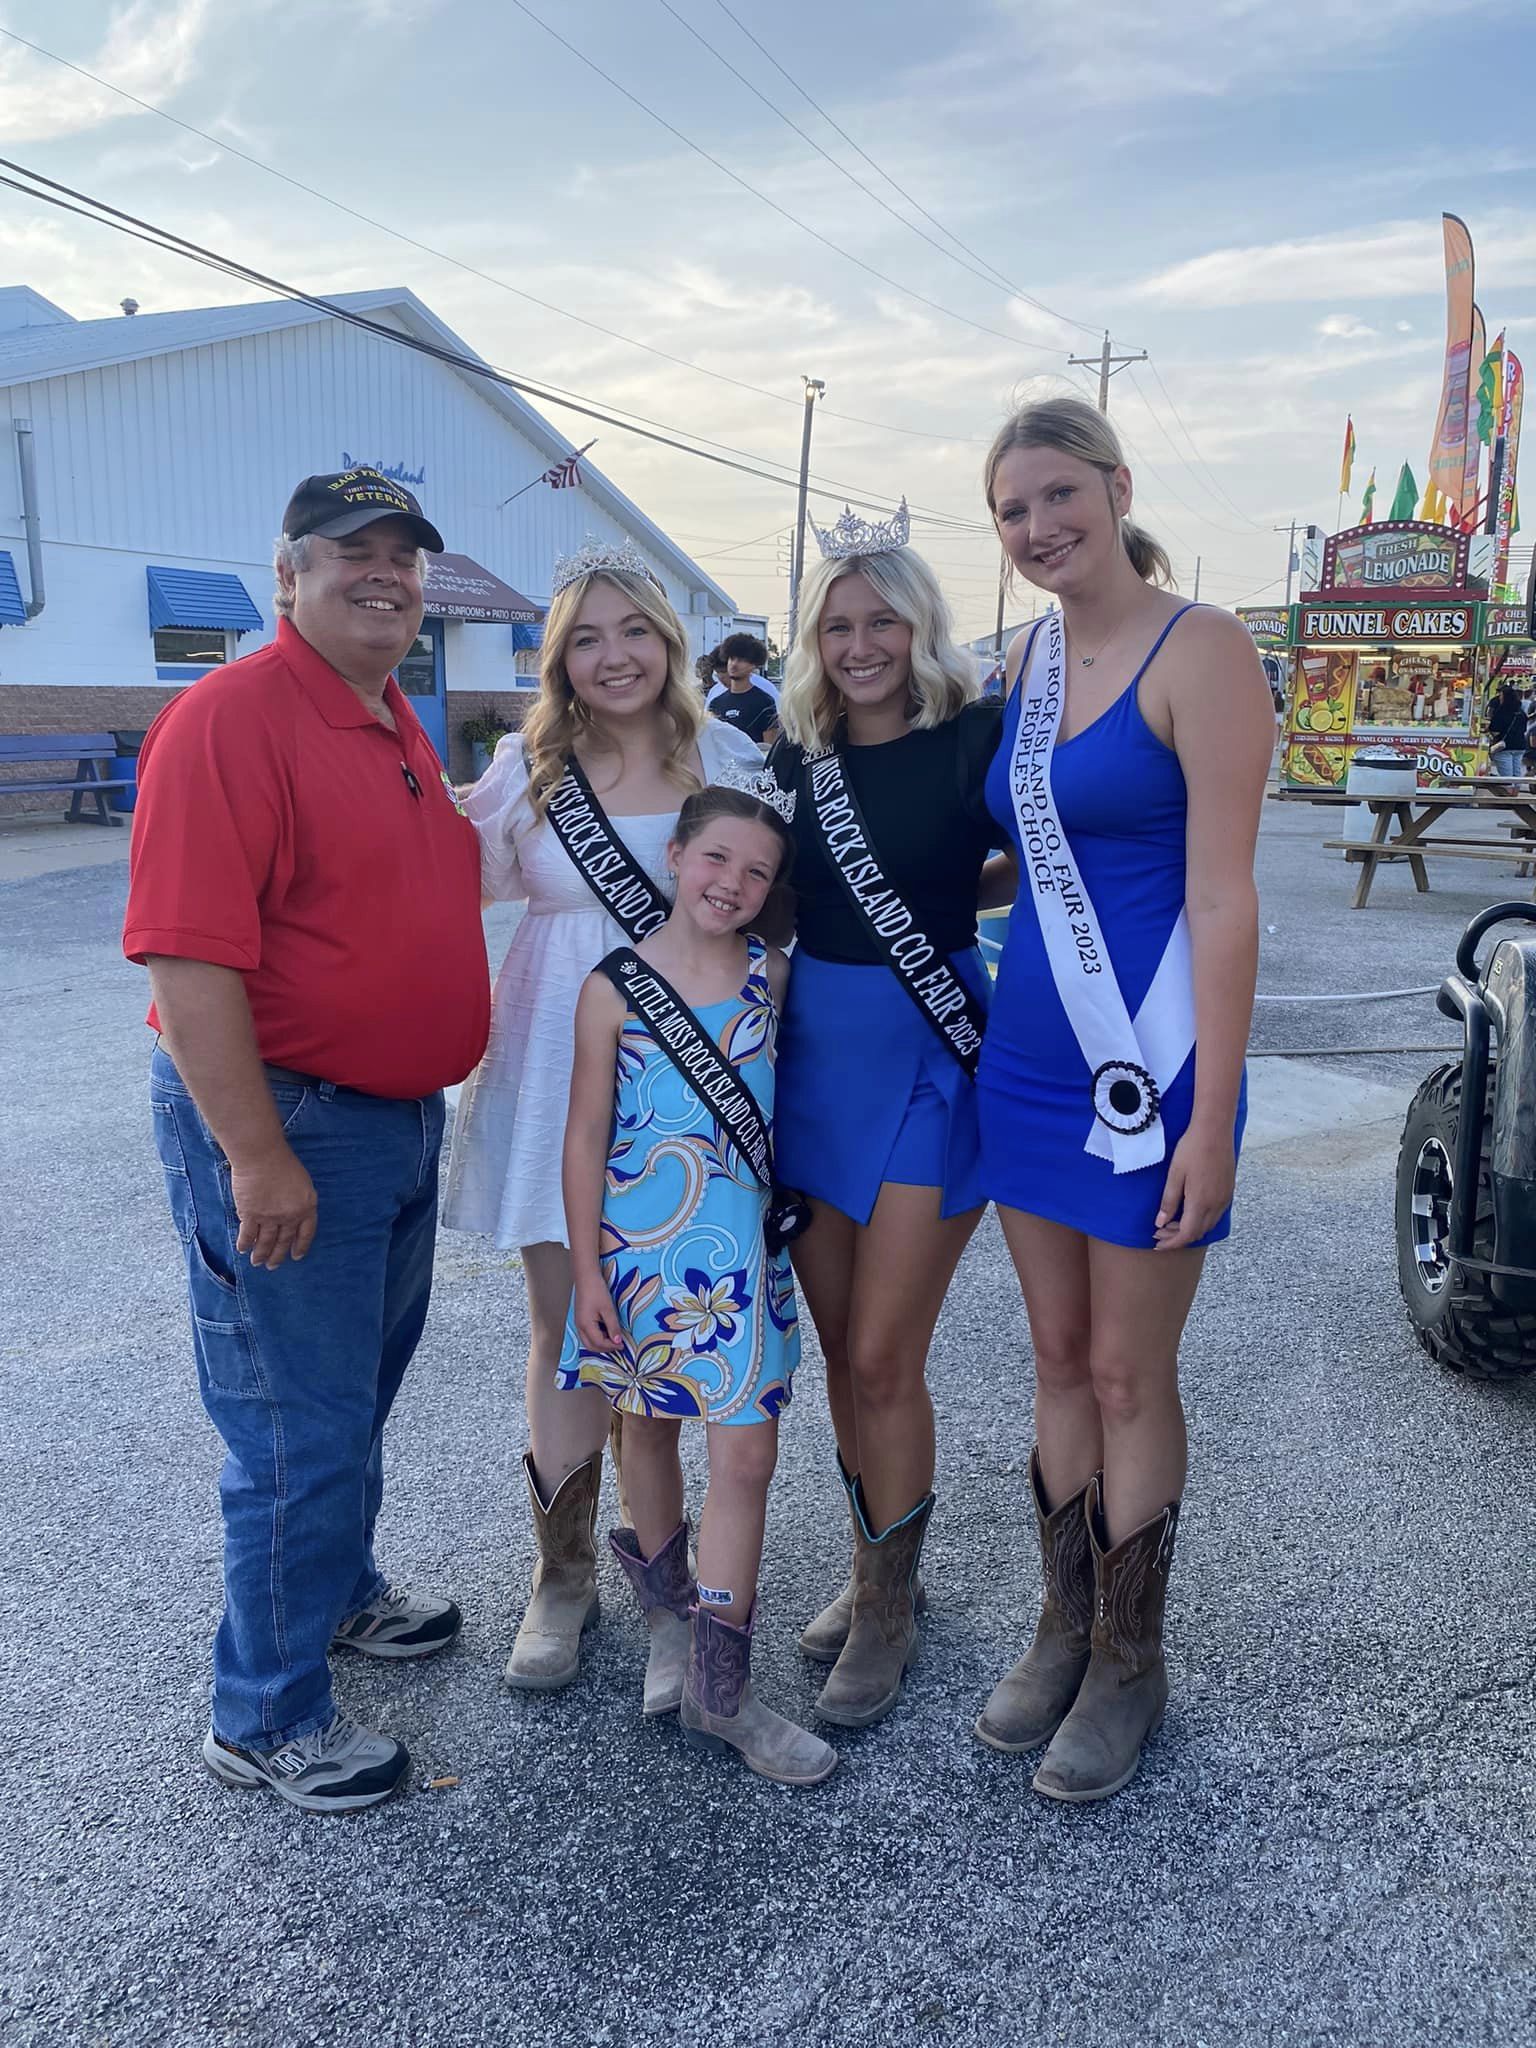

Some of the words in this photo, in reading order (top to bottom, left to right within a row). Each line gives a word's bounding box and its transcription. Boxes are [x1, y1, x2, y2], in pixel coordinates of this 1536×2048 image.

[327, 472, 359, 492] IRAQI
[343, 491, 410, 511] VETERAN
[1364, 551, 1450, 581] LEMONADE
[1379, 538, 1418, 556] FRESH
[447, 604, 486, 618] SUNROOMS
[492, 608, 509, 620] PATIO
[510, 611, 536, 622] COVERS
[1247, 620, 1288, 638] MONADE
[1305, 612, 1389, 636] FUNNEL
[1393, 612, 1466, 636] CAKES
[1488, 621, 1529, 637] LIMEA
[1504, 609, 1528, 619] CHER
[1040, 664, 1061, 725] ROCK
[1014, 697, 1042, 796] PEOPLE'S
[1416, 754, 1465, 777] DOGS
[548, 764, 586, 812] ISS
[812, 757, 844, 802] MISS
[1030, 728, 1051, 811] ISLAND
[554, 802, 608, 859] ROCK
[816, 793, 868, 864] ROCK
[1020, 802, 1056, 894] CHOICE
[1040, 816, 1061, 857] CO.
[581, 844, 653, 920] ISLAND
[840, 854, 913, 938] ISLAND
[1053, 862, 1085, 918] FAIR
[890, 932, 935, 977] CO.
[1071, 922, 1102, 976] 2023
[623, 973, 676, 1022] LITTLE
[912, 964, 967, 1024] FAIR
[655, 1009, 697, 1050] MISS
[943, 1014, 982, 1056] 2023
[676, 1039, 722, 1085] ROCK
[702, 1072, 751, 1126] ISLAND
[736, 1116, 760, 1148] CO.
[746, 1133, 767, 1171] FAIR
